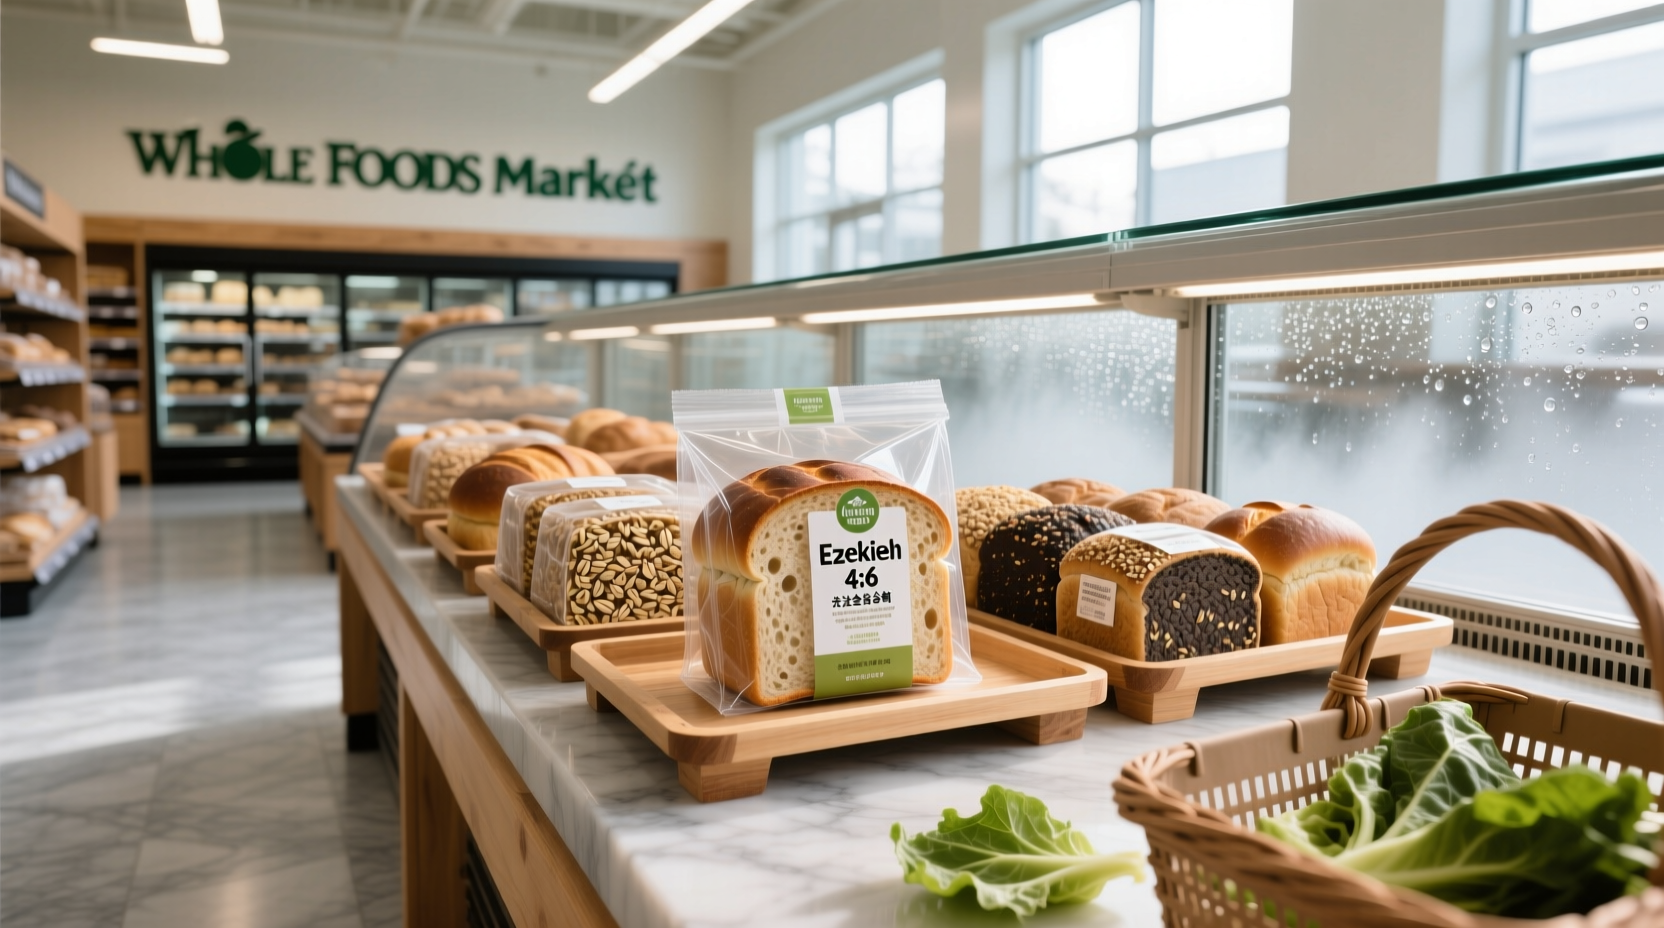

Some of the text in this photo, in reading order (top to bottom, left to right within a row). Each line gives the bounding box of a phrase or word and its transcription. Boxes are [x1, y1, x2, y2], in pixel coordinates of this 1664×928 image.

[124, 118, 314, 185] WHOLE
[325, 142, 483, 195] FOODS
[819, 538, 902, 566] Ezekieh
[844, 565, 879, 590] 4:6
